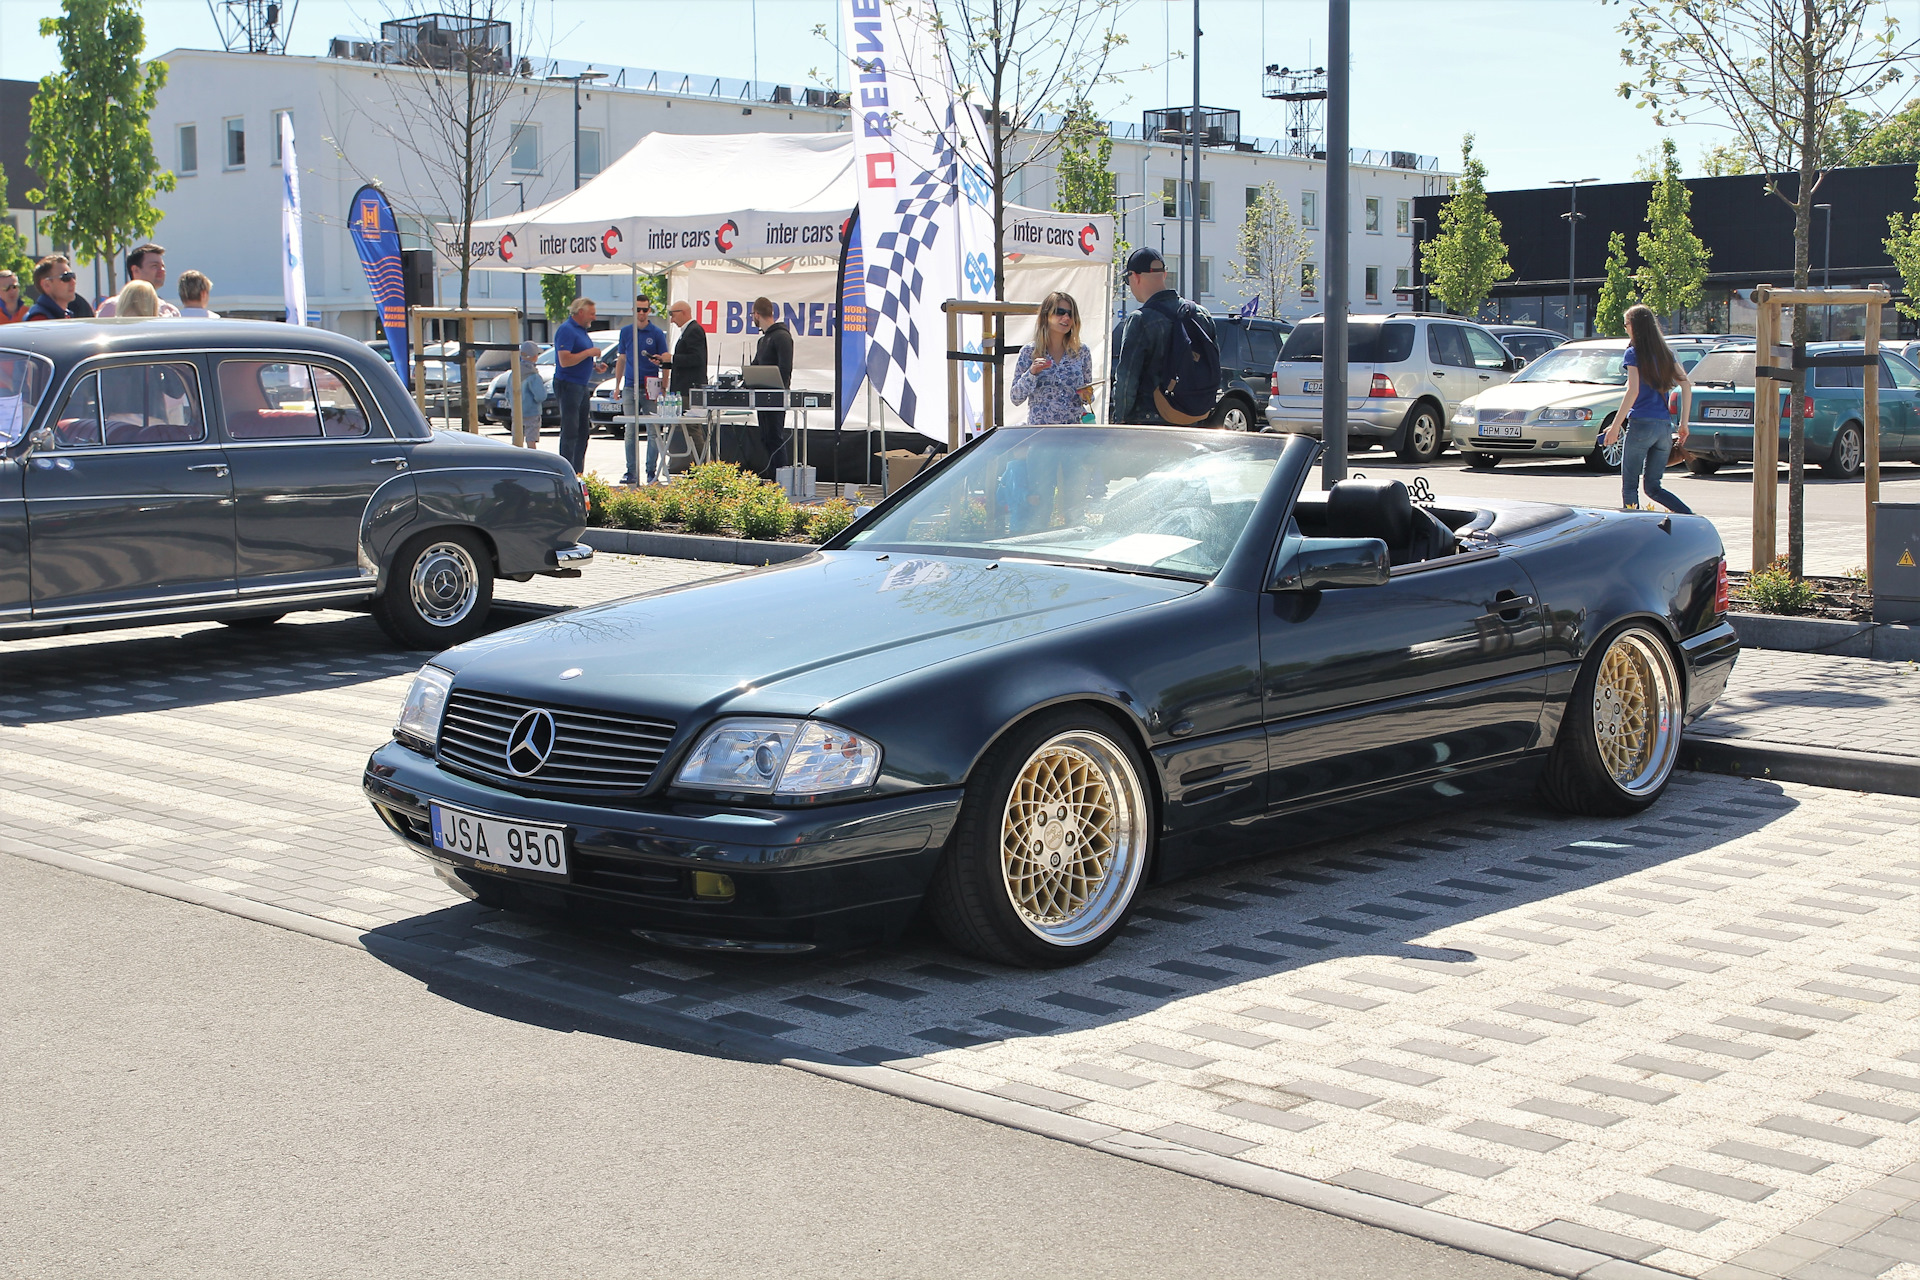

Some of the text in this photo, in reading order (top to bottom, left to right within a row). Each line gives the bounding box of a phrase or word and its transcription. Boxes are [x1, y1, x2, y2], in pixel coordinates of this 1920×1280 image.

[648, 228, 678, 250] inter
[681, 230, 710, 249] cars
[766, 222, 833, 244] inter cars
[1013, 219, 1043, 243] inter
[1046, 227, 1074, 247] cars
[445, 238, 466, 257] inte
[471, 240, 495, 257] cars
[540, 234, 567, 255] inter
[570, 236, 597, 254] cars
[1708, 408, 1750, 418] FTJ 374
[1483, 426, 1519, 436] HPM 974
[433, 830, 442, 842] LT
[444, 815, 561, 869] JSA 950
